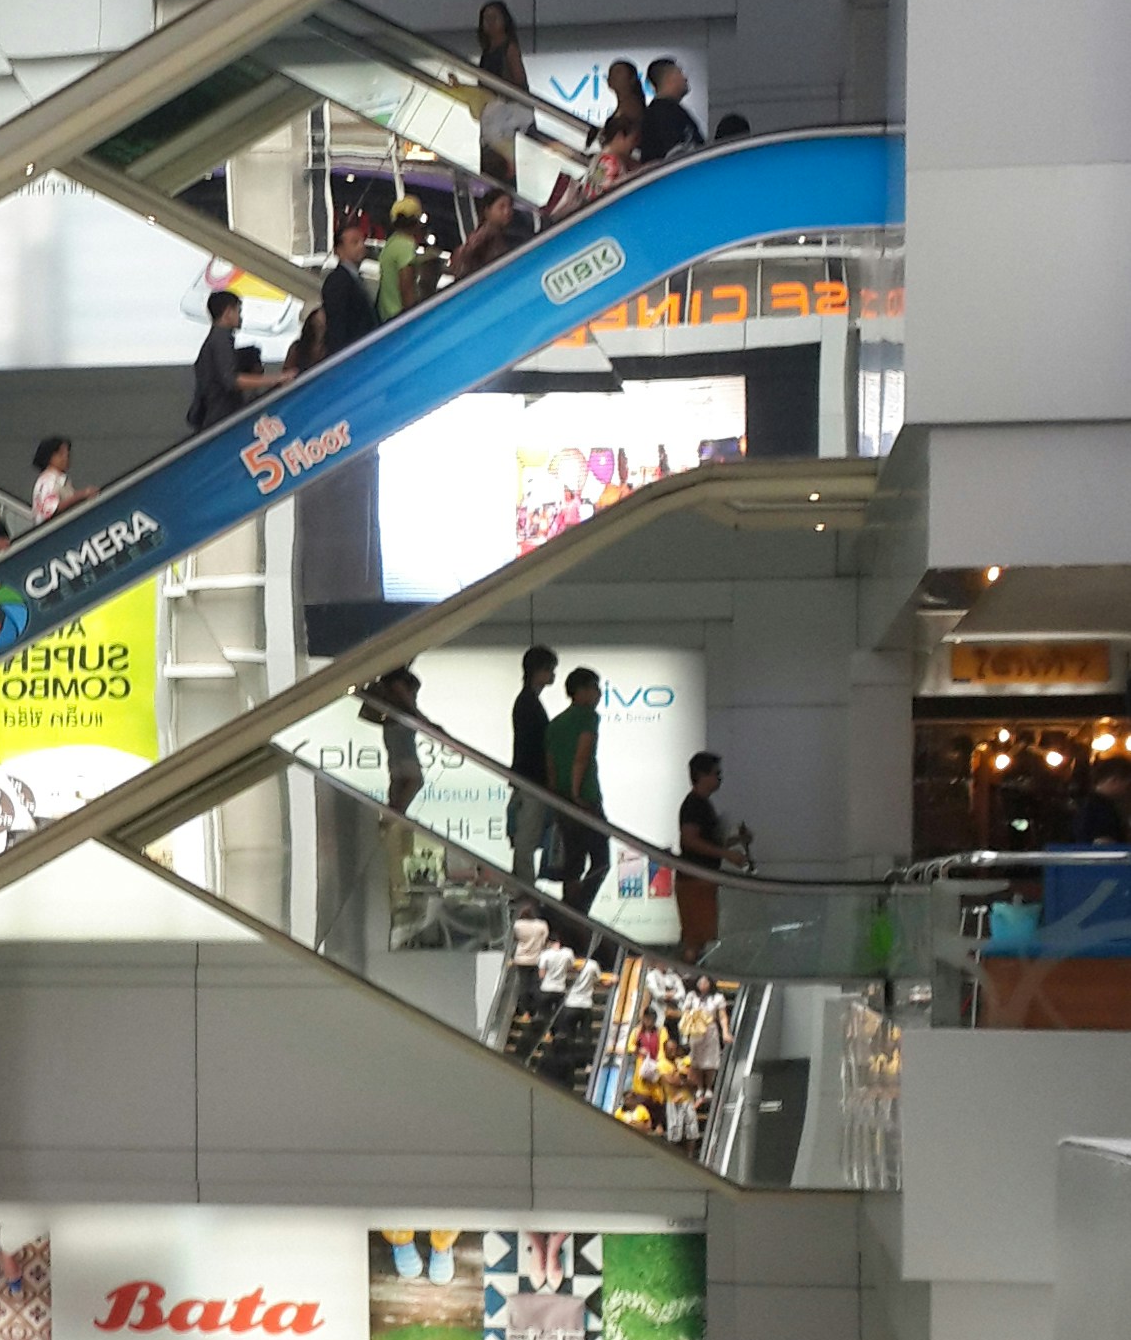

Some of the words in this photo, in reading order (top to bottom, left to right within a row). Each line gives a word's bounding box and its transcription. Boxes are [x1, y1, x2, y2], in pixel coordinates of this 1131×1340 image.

[281, 420, 352, 477] Floor
[25, 509, 160, 599] CAMERA
[599, 679, 675, 709] ivo
[94, 1279, 325, 1336] Bata
